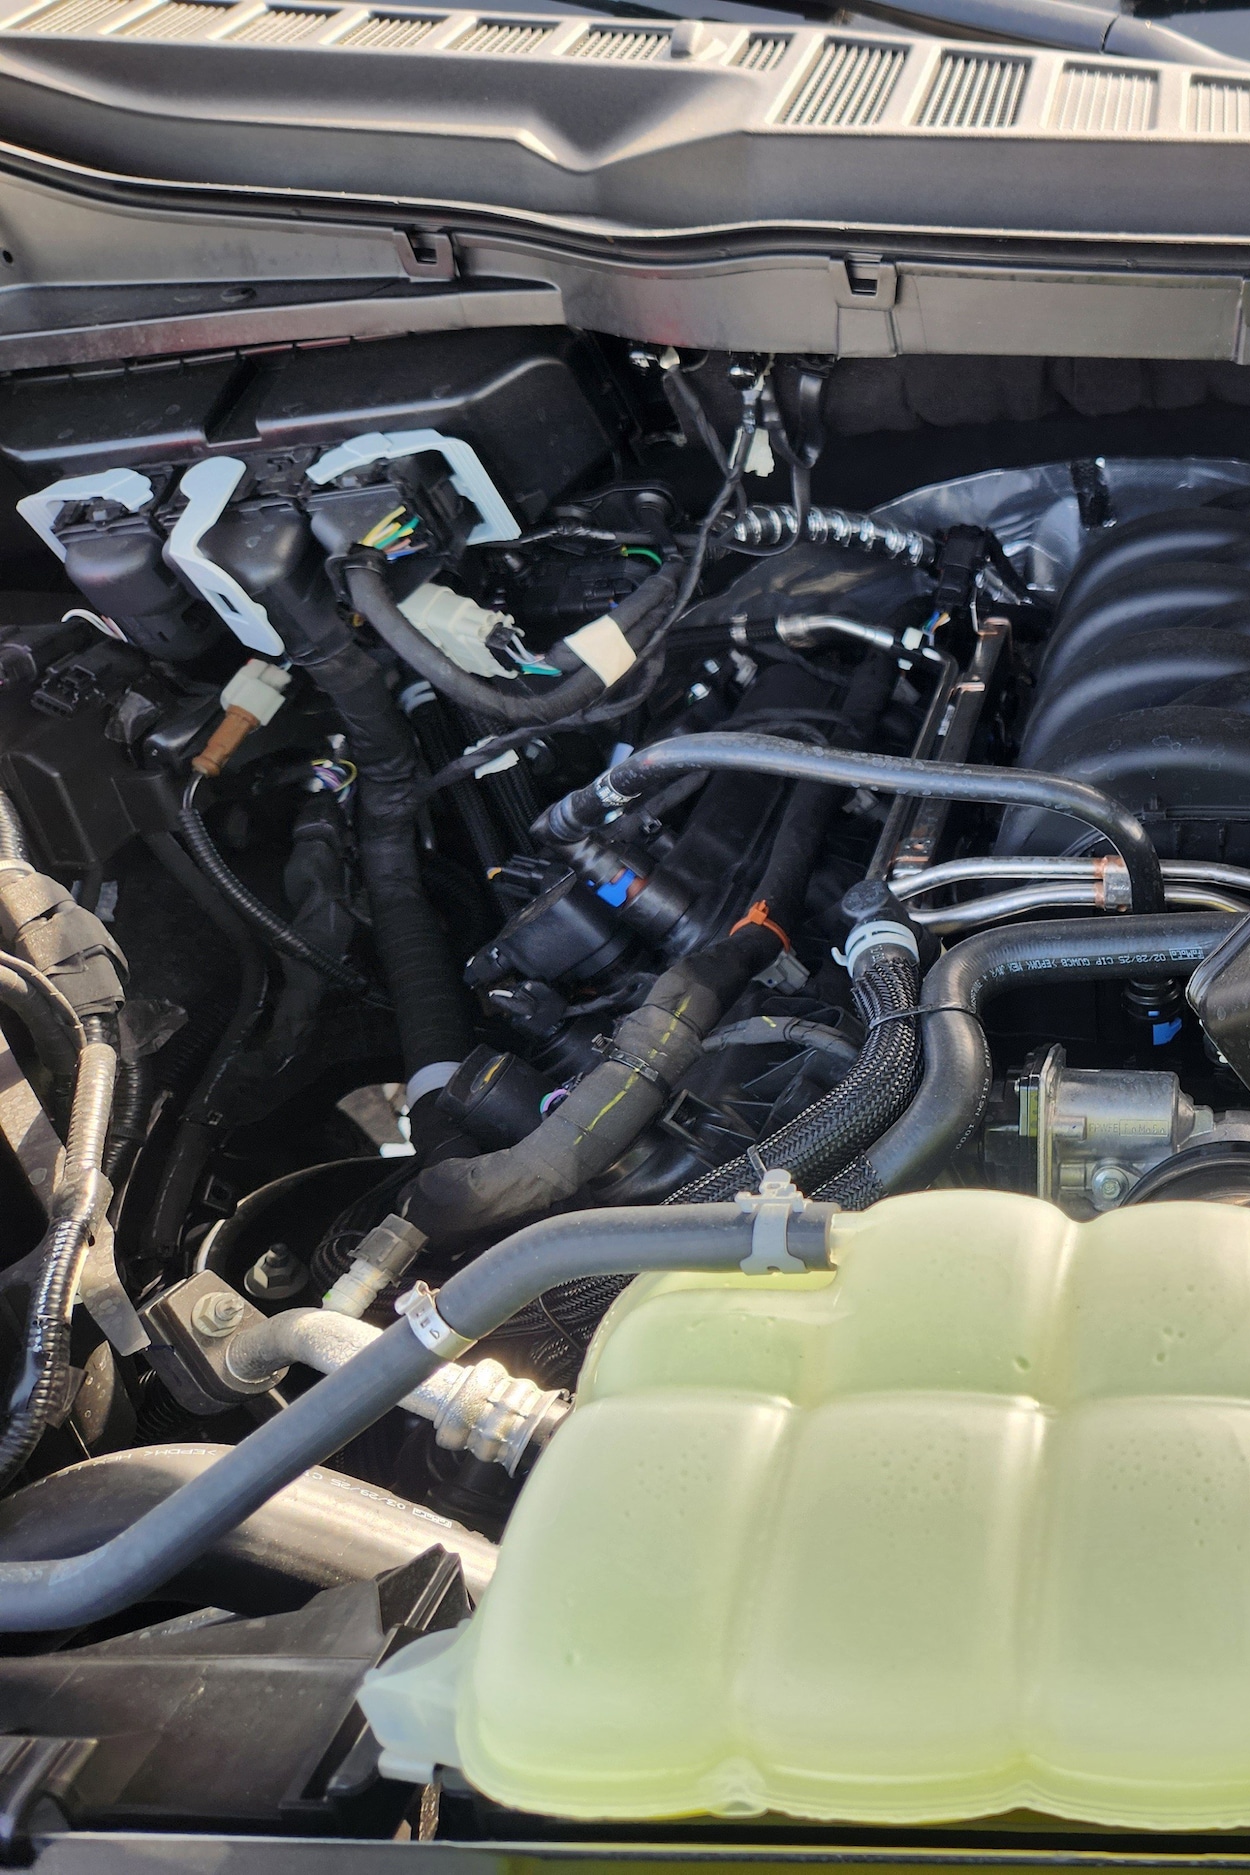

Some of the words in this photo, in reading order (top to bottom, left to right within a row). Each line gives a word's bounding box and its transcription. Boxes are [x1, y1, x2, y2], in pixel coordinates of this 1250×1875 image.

[1095, 956, 1114, 966] CIP
[1118, 952, 1166, 965] 02/28/25
[329, 1479, 406, 1510] 03/29/25
